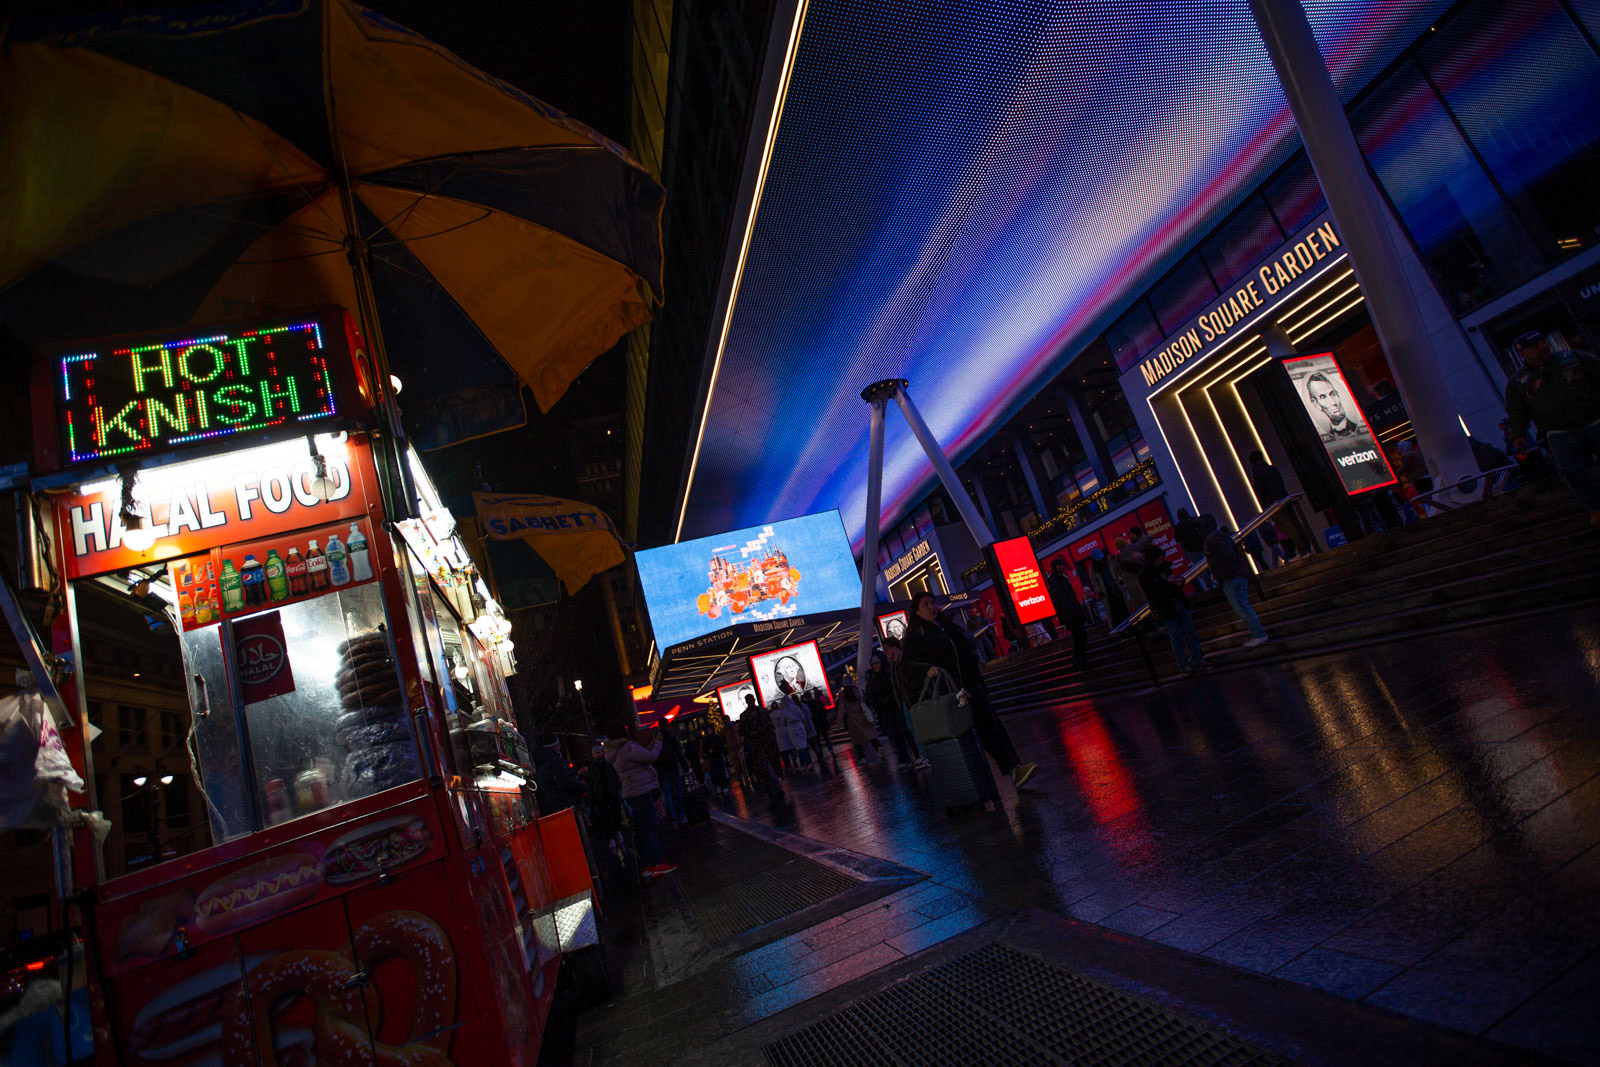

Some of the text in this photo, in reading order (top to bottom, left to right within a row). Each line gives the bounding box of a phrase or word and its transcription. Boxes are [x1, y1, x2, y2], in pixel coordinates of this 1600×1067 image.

[1140, 221, 1341, 388] MADISON SQUARE GARDEN
[131, 338, 256, 393] HOT
[94, 376, 300, 447] KNISH
[1337, 449, 1378, 467] verizon
[232, 456, 352, 521] FOOD
[1144, 517, 1163, 529] Happy
[1018, 595, 1046, 607] verizon
[671, 629, 734, 656] PENN STATION
[240, 662, 276, 678] HALAL
